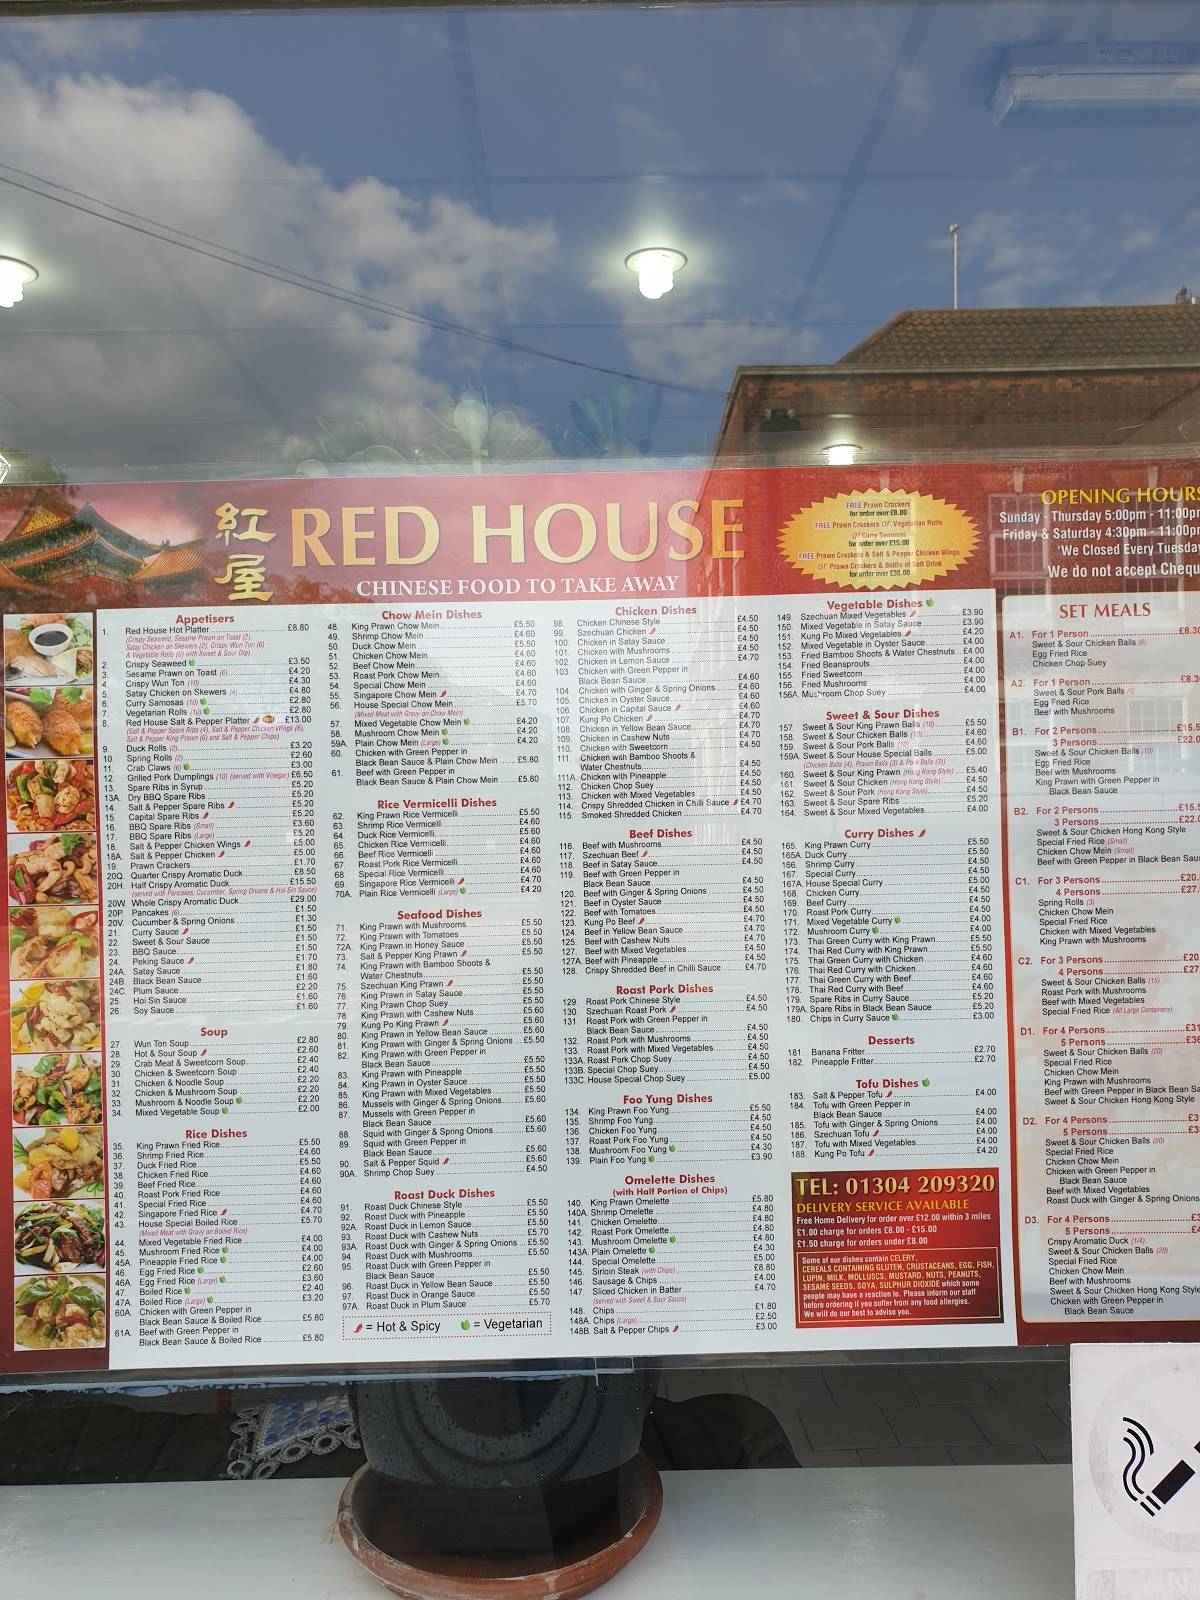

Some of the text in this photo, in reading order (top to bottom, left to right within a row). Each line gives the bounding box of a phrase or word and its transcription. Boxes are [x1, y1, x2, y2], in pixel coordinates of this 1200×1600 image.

[1040, 488, 1130, 504] OPENING
[999, 511, 1040, 524] Sunday
[1051, 509, 1101, 523] Thursday
[1104, 508, 1146, 522] 5:00pm
[291, 499, 745, 568] RED HOUSE
[1002, 528, 1037, 542] Friday
[1041, 527, 1049, 539] &
[1053, 526, 1102, 540] Saturday
[1105, 526, 1147, 540] 4:30pm
[1082, 543, 1120, 556] Closed
[1123, 543, 1154, 556] Every
[1047, 564, 1068, 578] We
[1072, 564, 1087, 577] do
[1091, 564, 1111, 577] not
[1114, 563, 1156, 578] accept
[356, 575, 678, 596] CHINESE FOOD TO TAKE AWAY
[615, 604, 697, 616] Chicken Dishes
[826, 599, 922, 612] Vegetable Dishes
[1059, 602, 1151, 618] SET MEALS
[175, 613, 234, 628] Appetisers
[381, 609, 482, 620] Chow Mein Dishes
[125, 623, 309, 636] Red House Hot Platter £8.80
[1009, 631, 1024, 639] A1.
[1032, 630, 1046, 638] For
[1057, 630, 1088, 638] Person
[352, 640, 536, 650] Duck Chow Mein £5.50
[1032, 650, 1048, 659] Egg
[826, 708, 940, 722] Sweet & Sour Dishes
[377, 797, 496, 809] Rice Vermicelli Dishes
[357, 827, 540, 839] Duck Rice Vermicelli £5.60
[629, 827, 692, 838] Beef Dishes
[844, 827, 914, 842] Curry Dishes
[804, 856, 989, 871] Shrimp Curry £4.50
[397, 908, 482, 920] Seafood Dishes
[616, 983, 713, 995] Roast Pork Dishes
[200, 1027, 228, 1038] Soup
[868, 1035, 915, 1045] Desserts
[134, 1046, 318, 1058] Hot & Sour Soup £2.60
[842, 1047, 865, 1055] Fritter
[974, 1044, 996, 1053] £2.70
[855, 1078, 919, 1089] Tofu Dishes
[623, 1093, 712, 1108] Foo Yung Dishes
[185, 1128, 247, 1139] Rice Dishes
[588, 1123, 772, 1135] Chicken Foo Yung £4.50
[137, 1176, 321, 1189] Beef Fried Rice £4.60
[624, 1173, 715, 1185] Omelette Dishes
[795, 1174, 994, 1195] TEL: 01304 209320
[394, 1188, 495, 1200] Roast Duck Dishes
[612, 1187, 633, 1198] (with
[636, 1187, 654, 1195] Half
[657, 1186, 688, 1195] Portion
[701, 1186, 727, 1195] Chips)
[364, 1198, 548, 1211] Roast Duck Chinese Style £5.50
[796, 1199, 968, 1213] DELIVERY SERVICE AVAILABLE
[796, 1216, 812, 1224] Free
[814, 1216, 834, 1224] Home
[836, 1215, 866, 1224] Delivery
[866, 1214, 877, 1222] for
[878, 1214, 897, 1222] order
[915, 1213, 940, 1221] £12.00
[941, 1212, 963, 1221] within
[964, 1212, 969, 1220] 3
[971, 1212, 991, 1220] miles
[376, 1320, 440, 1333] Hot & Spicy
[483, 1317, 542, 1332] Vegetarian
